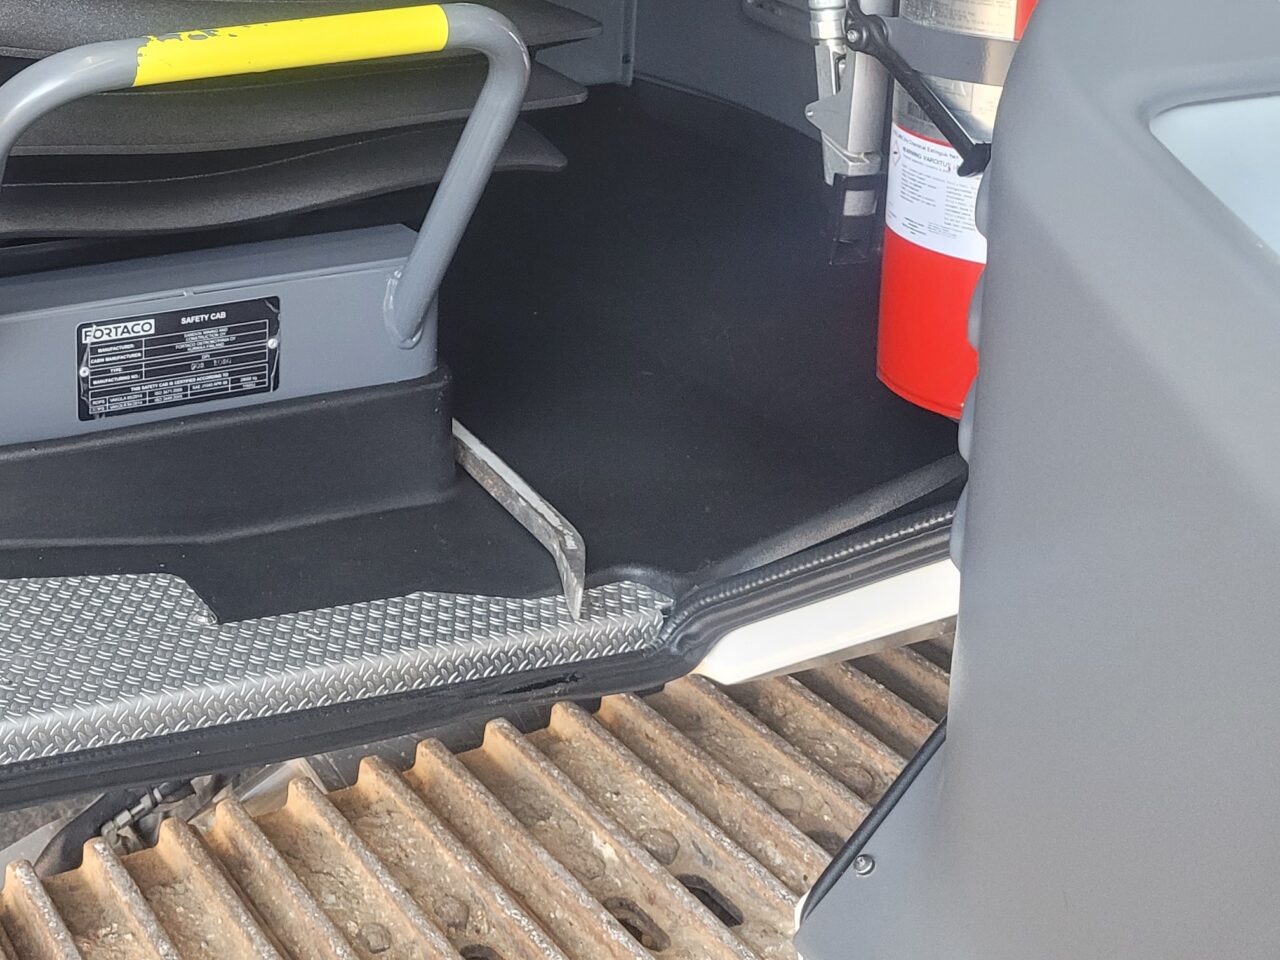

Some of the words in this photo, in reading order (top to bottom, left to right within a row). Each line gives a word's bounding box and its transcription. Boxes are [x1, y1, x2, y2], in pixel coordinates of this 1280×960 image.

[181, 314, 209, 325] SAFETY
[211, 312, 226, 320] CAB
[84, 322, 152, 341] FORTACO
